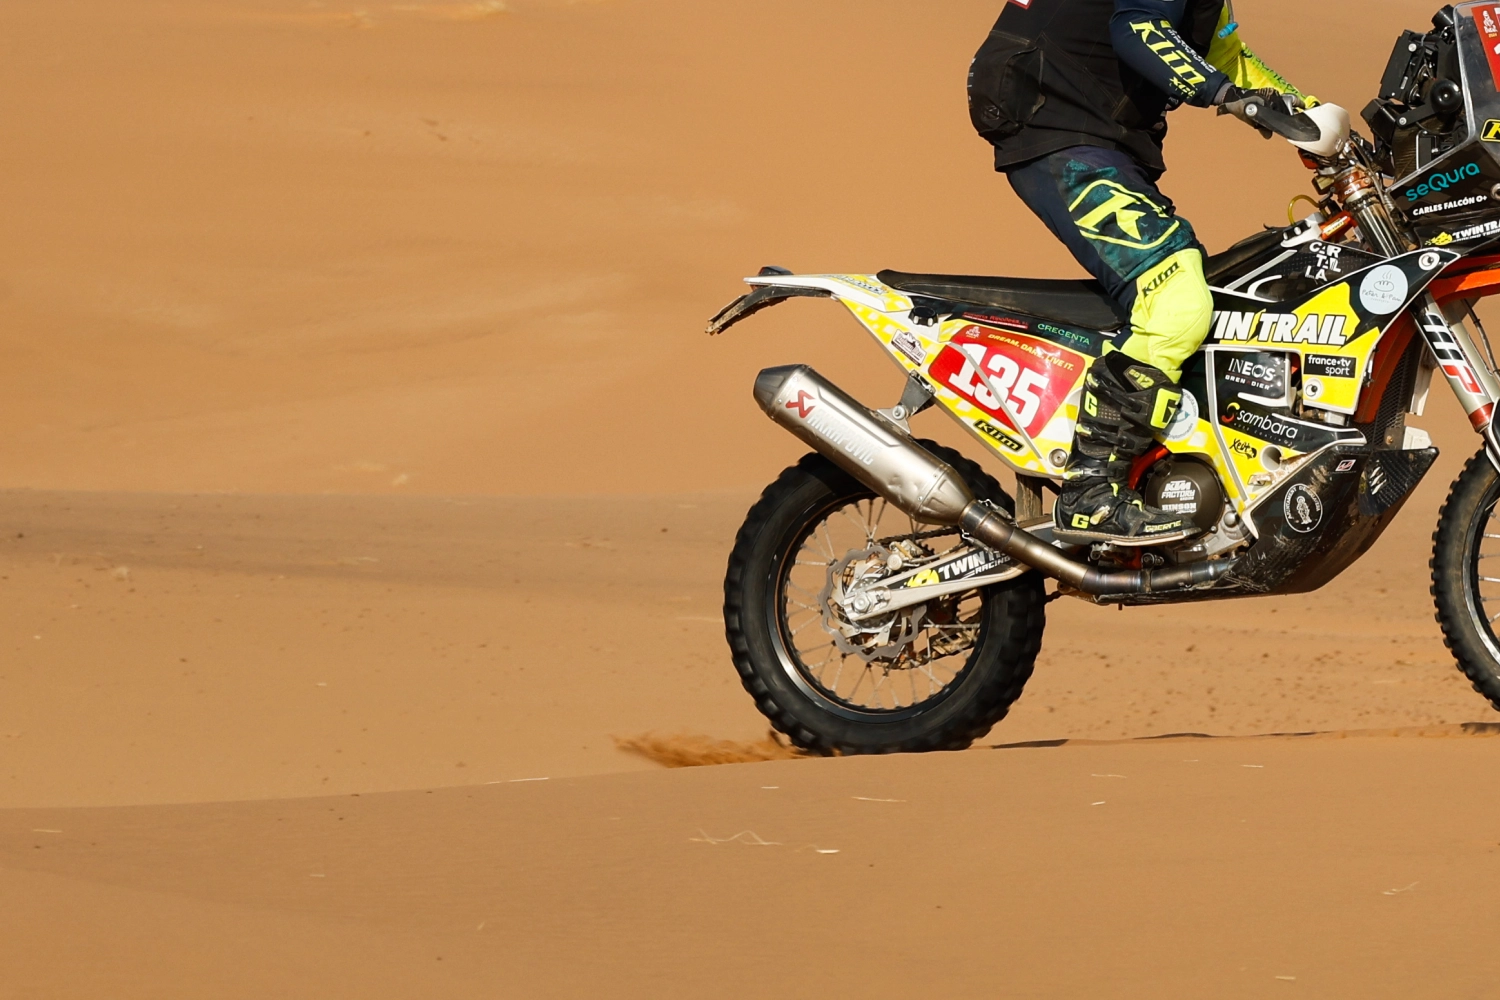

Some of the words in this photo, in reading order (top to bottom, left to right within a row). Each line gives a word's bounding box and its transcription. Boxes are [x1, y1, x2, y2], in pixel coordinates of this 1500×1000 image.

[1405, 163, 1480, 201] seQura
[1413, 204, 1443, 216] CARLES
[1443, 196, 1475, 210] FALCÓN
[1452, 224, 1484, 239] TWIN
[988, 333, 1020, 347] DREAM.
[1037, 323, 1090, 345] CRECENTA
[1257, 313, 1347, 345] TRAIL
[1228, 358, 1276, 381] INEOS
[1325, 366, 1350, 377] sport
[948, 343, 1049, 428] 135
[1236, 410, 1298, 439] sambara
[1161, 489, 1195, 499] FACTORY
[1164, 480, 1191, 491] KTM
[938, 551, 985, 580] TWIN
